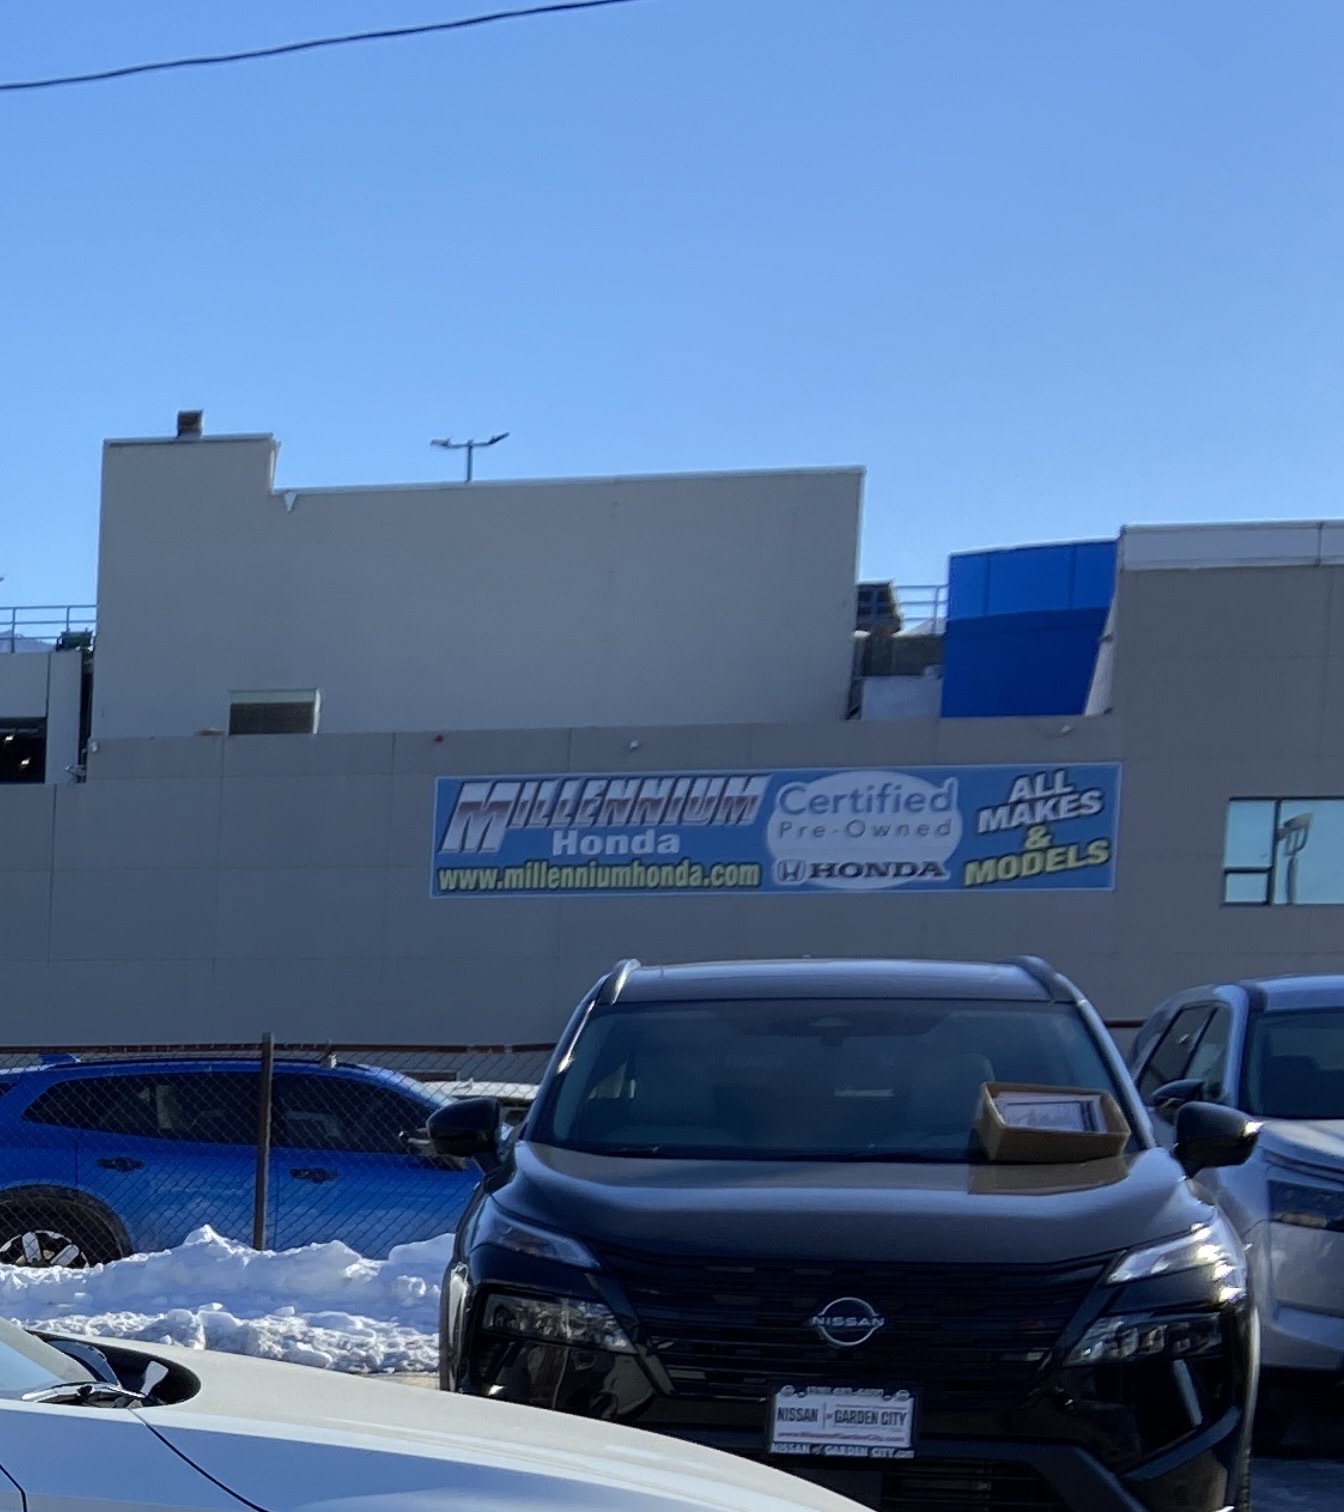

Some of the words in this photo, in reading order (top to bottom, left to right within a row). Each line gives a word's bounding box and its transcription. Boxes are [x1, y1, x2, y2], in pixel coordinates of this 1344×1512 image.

[778, 780, 955, 816] Certified
[1009, 770, 1075, 804] ALL
[438, 774, 771, 854] MILLENNIUM
[977, 788, 1105, 834] MAKES
[552, 829, 681, 857] Honda
[778, 818, 953, 839] Pre-Owned
[1023, 824, 1053, 850] &
[438, 858, 761, 891] www.millenniumhonda.com
[808, 860, 949, 879] HONDA
[964, 838, 1111, 887] MODELS
[811, 1316, 885, 1328] NISSAN
[777, 1407, 819, 1423] NISSAN
[834, 1409, 879, 1425] GARDEN
[881, 1411, 908, 1427] CITY
